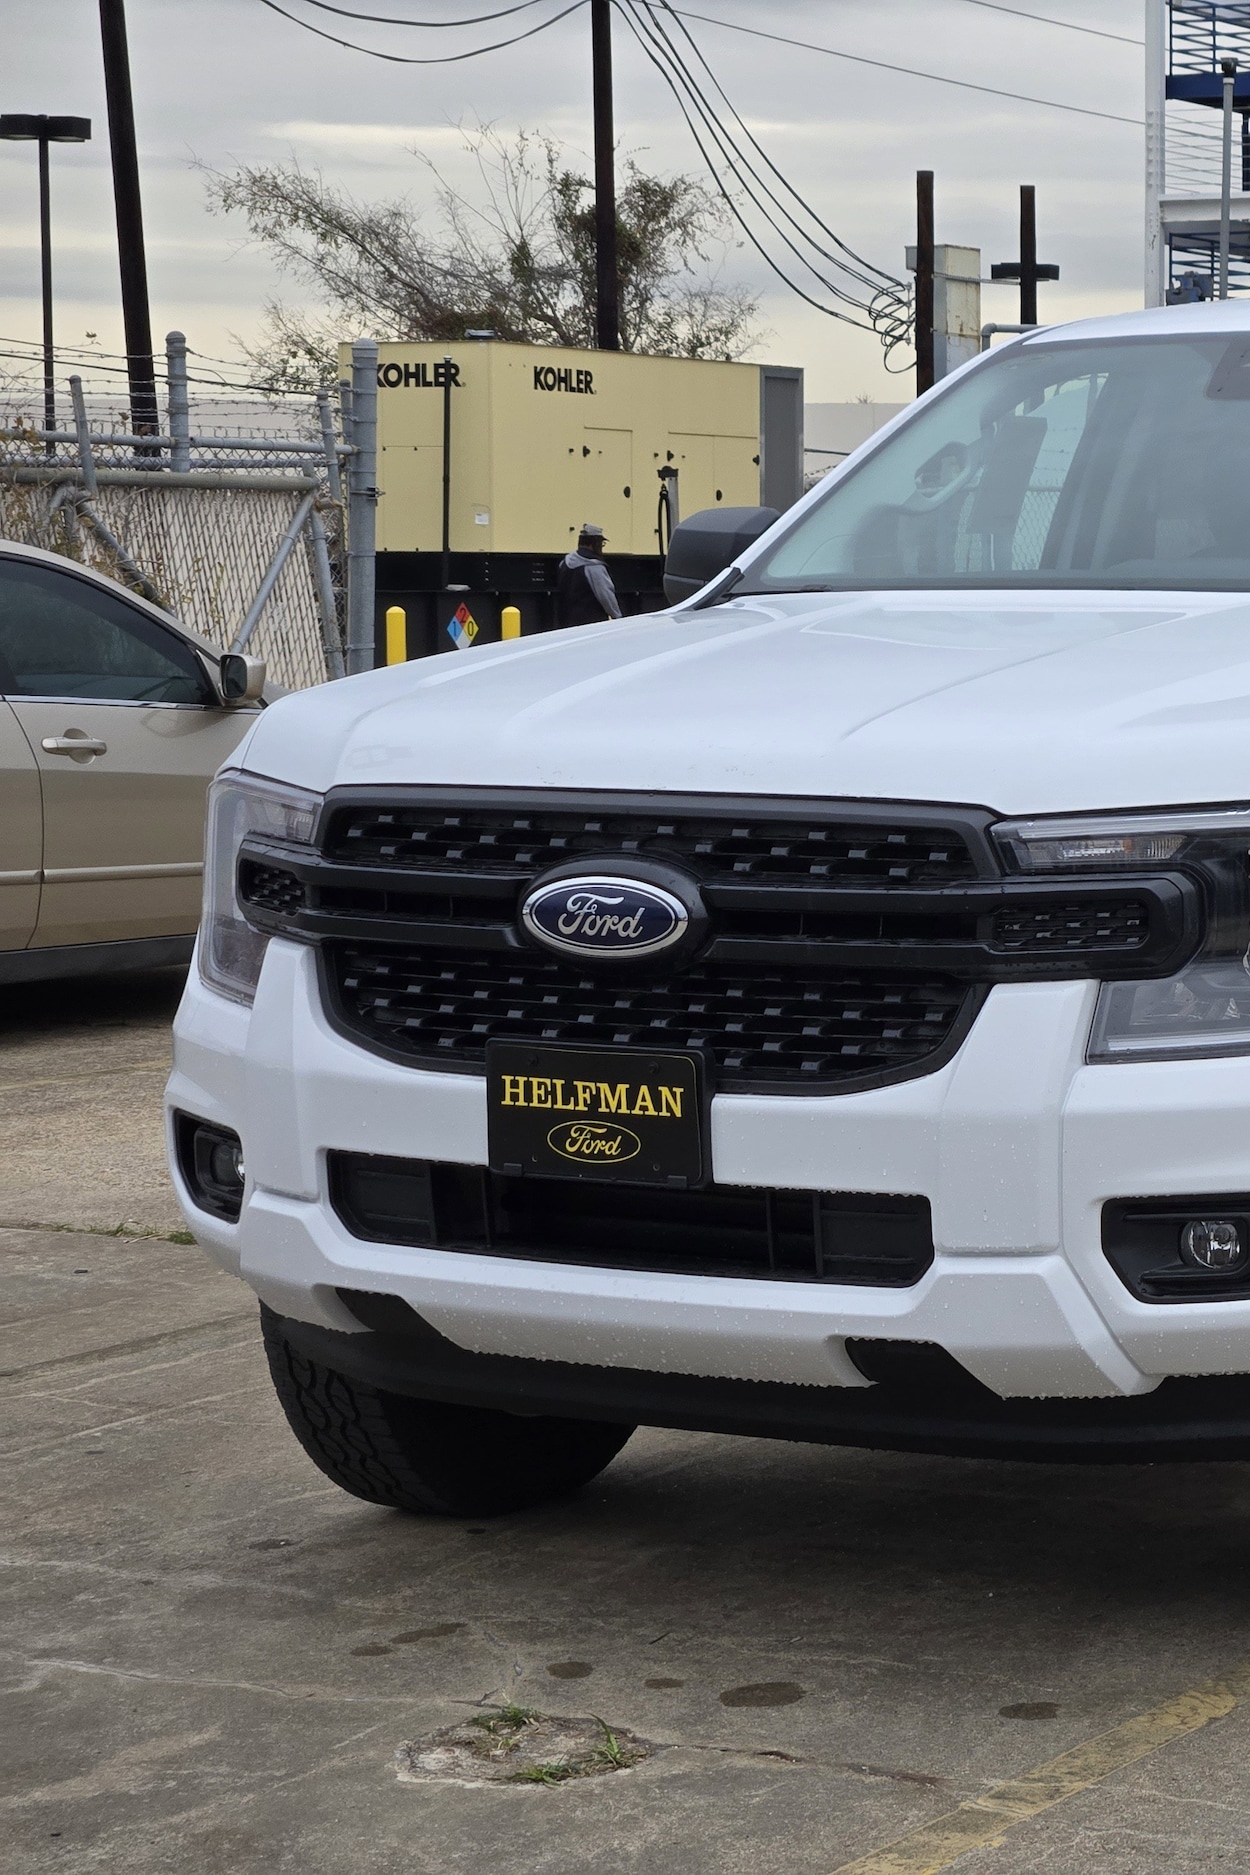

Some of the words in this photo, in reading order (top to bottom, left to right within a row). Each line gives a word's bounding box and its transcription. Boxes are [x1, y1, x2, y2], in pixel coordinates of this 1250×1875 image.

[533, 365, 594, 395] KOHLER
[452, 621, 457, 637] 1
[460, 607, 467, 623] 2
[467, 620, 474, 637] 0
[558, 892, 646, 939] Ford
[501, 1074, 684, 1118] HELFMAN
[565, 1123, 622, 1156] Ford
